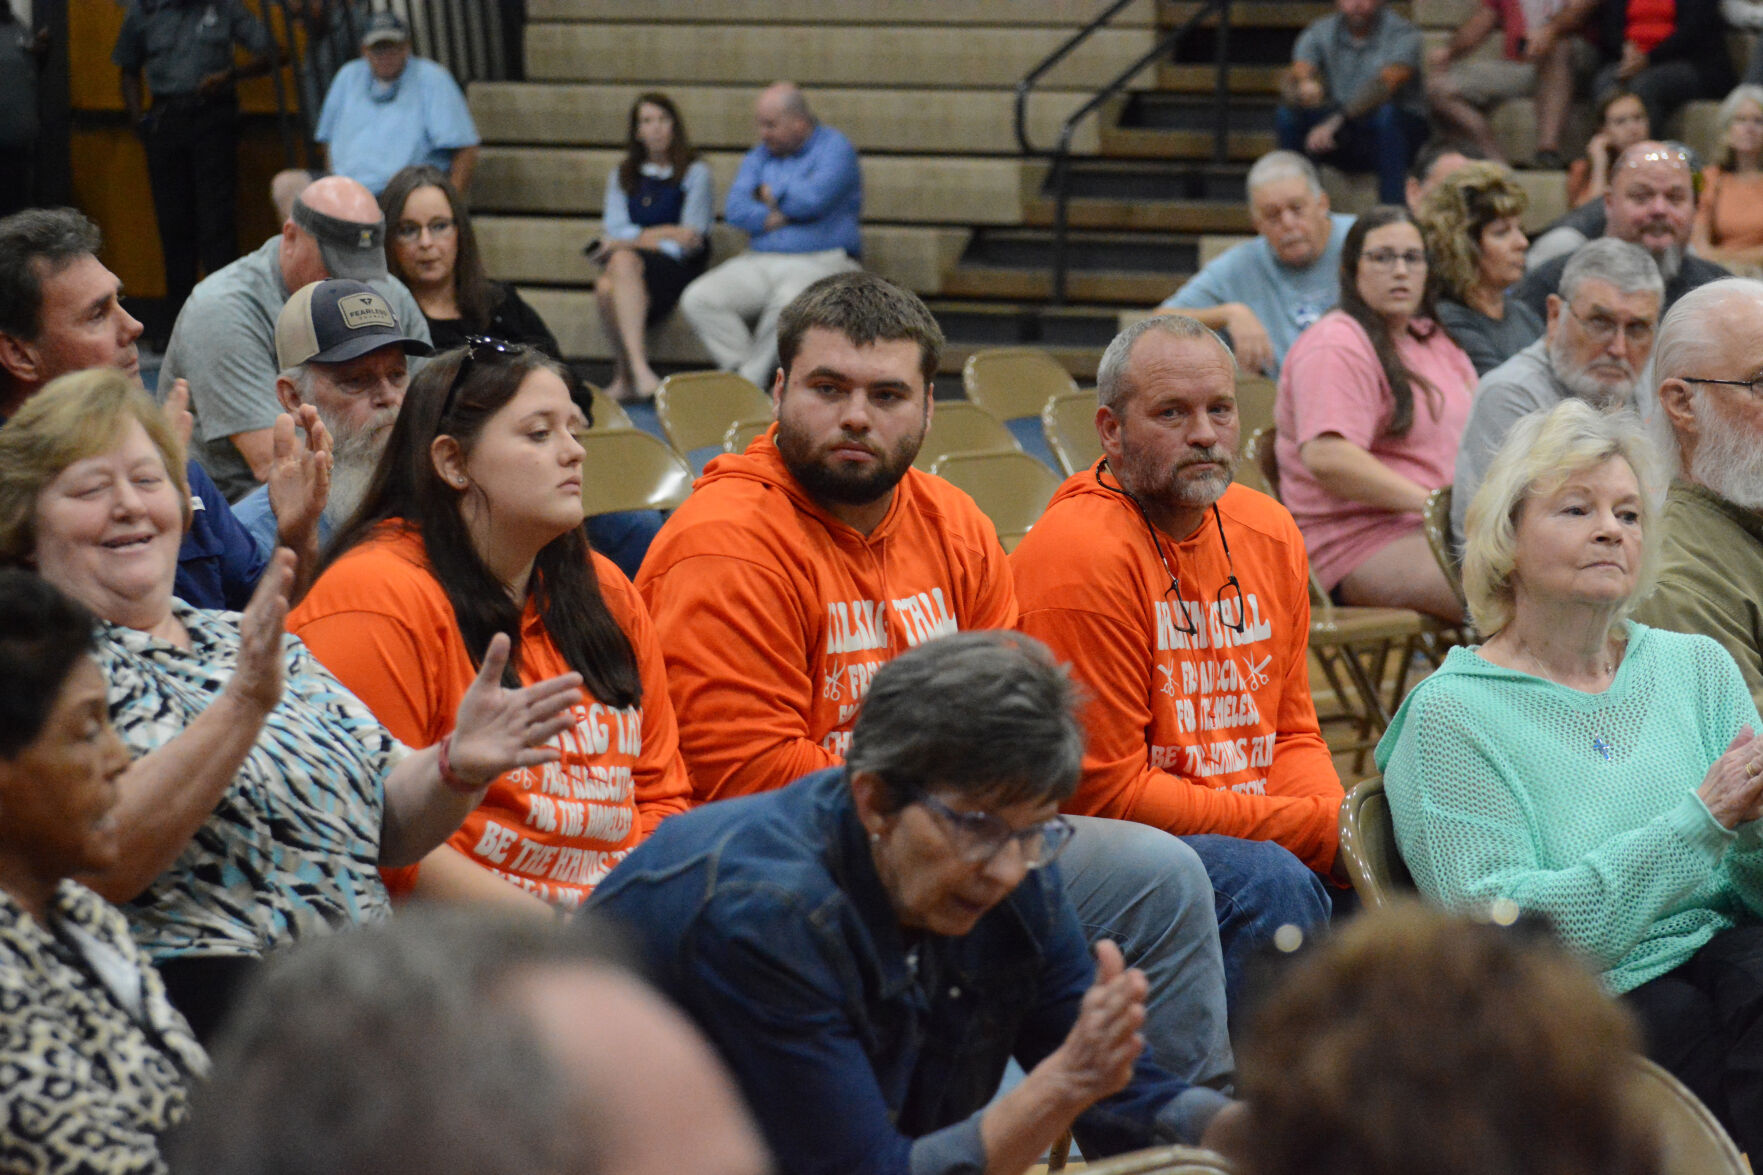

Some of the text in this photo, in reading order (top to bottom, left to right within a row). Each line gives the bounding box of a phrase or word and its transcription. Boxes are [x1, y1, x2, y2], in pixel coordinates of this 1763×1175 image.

[891, 587, 959, 648] TALL
[1151, 745, 1181, 768] BE
[527, 794, 557, 832] FOR
[557, 800, 584, 837] THE
[474, 821, 518, 864] BE
[511, 839, 559, 876] THE
[548, 846, 610, 886] HANDS
